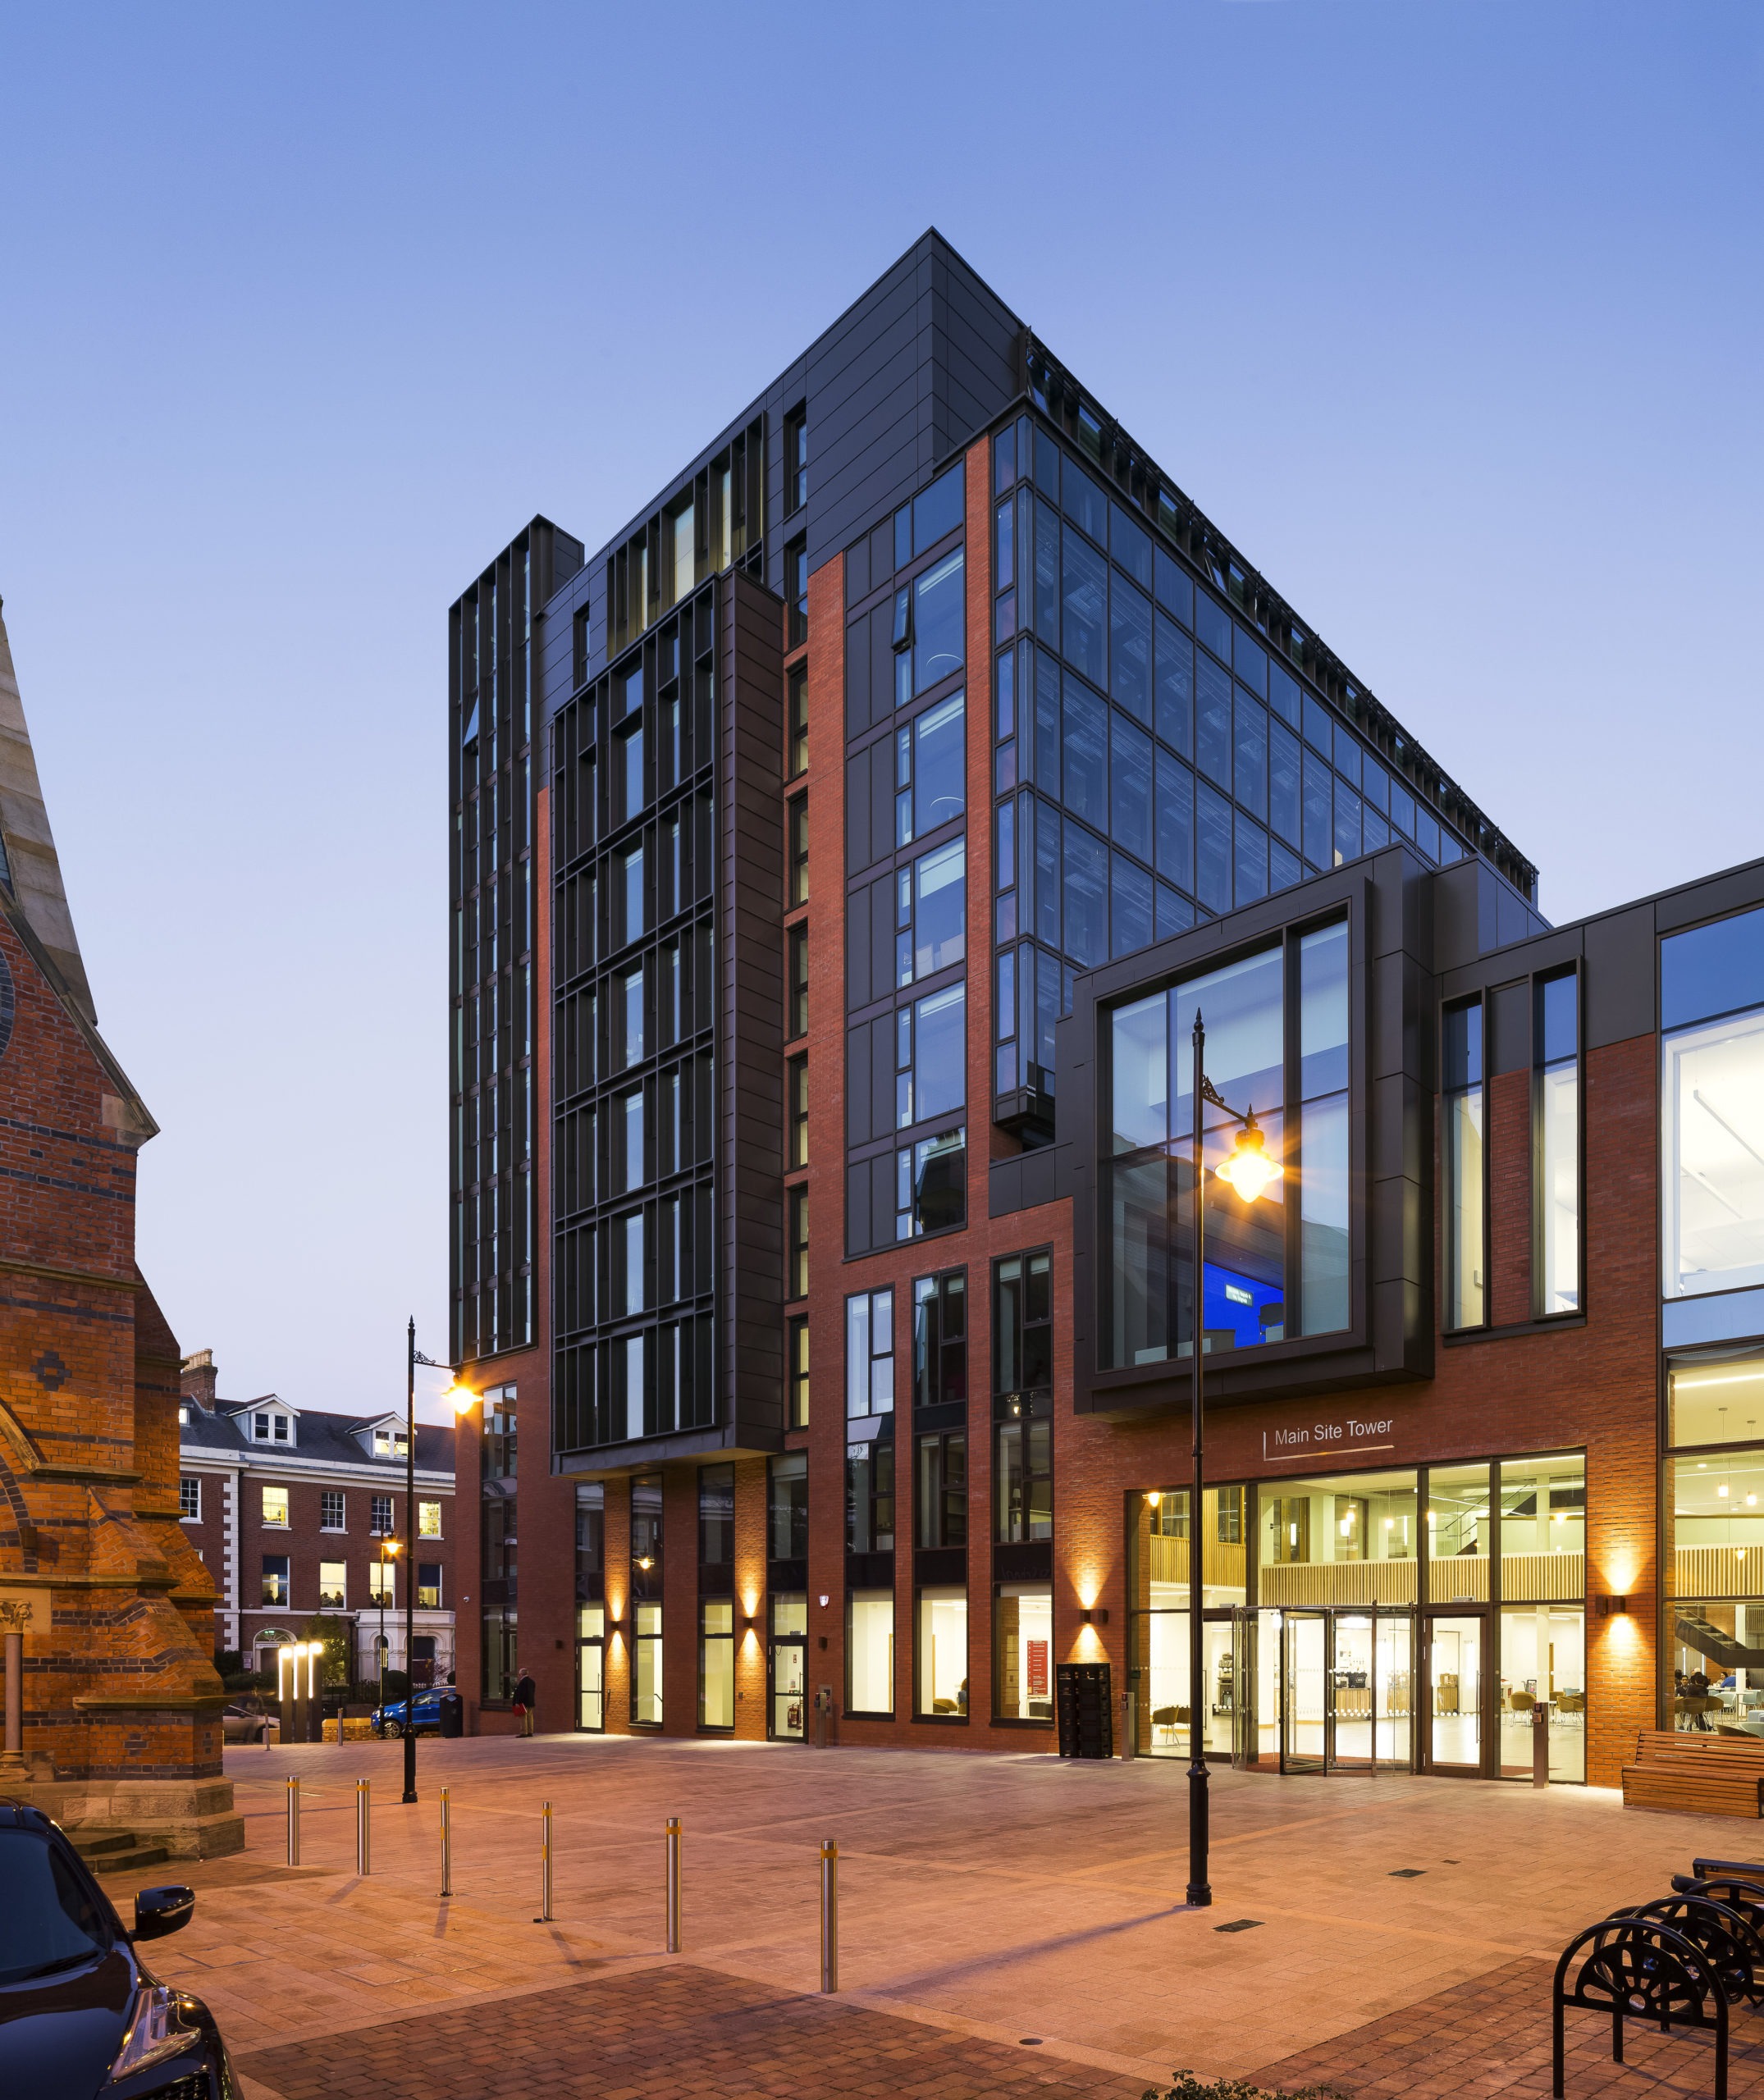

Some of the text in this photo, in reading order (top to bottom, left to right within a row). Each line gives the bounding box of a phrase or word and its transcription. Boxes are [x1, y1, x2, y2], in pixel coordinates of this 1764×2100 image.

[1275, 1419, 1393, 1445] Main Site Tower
